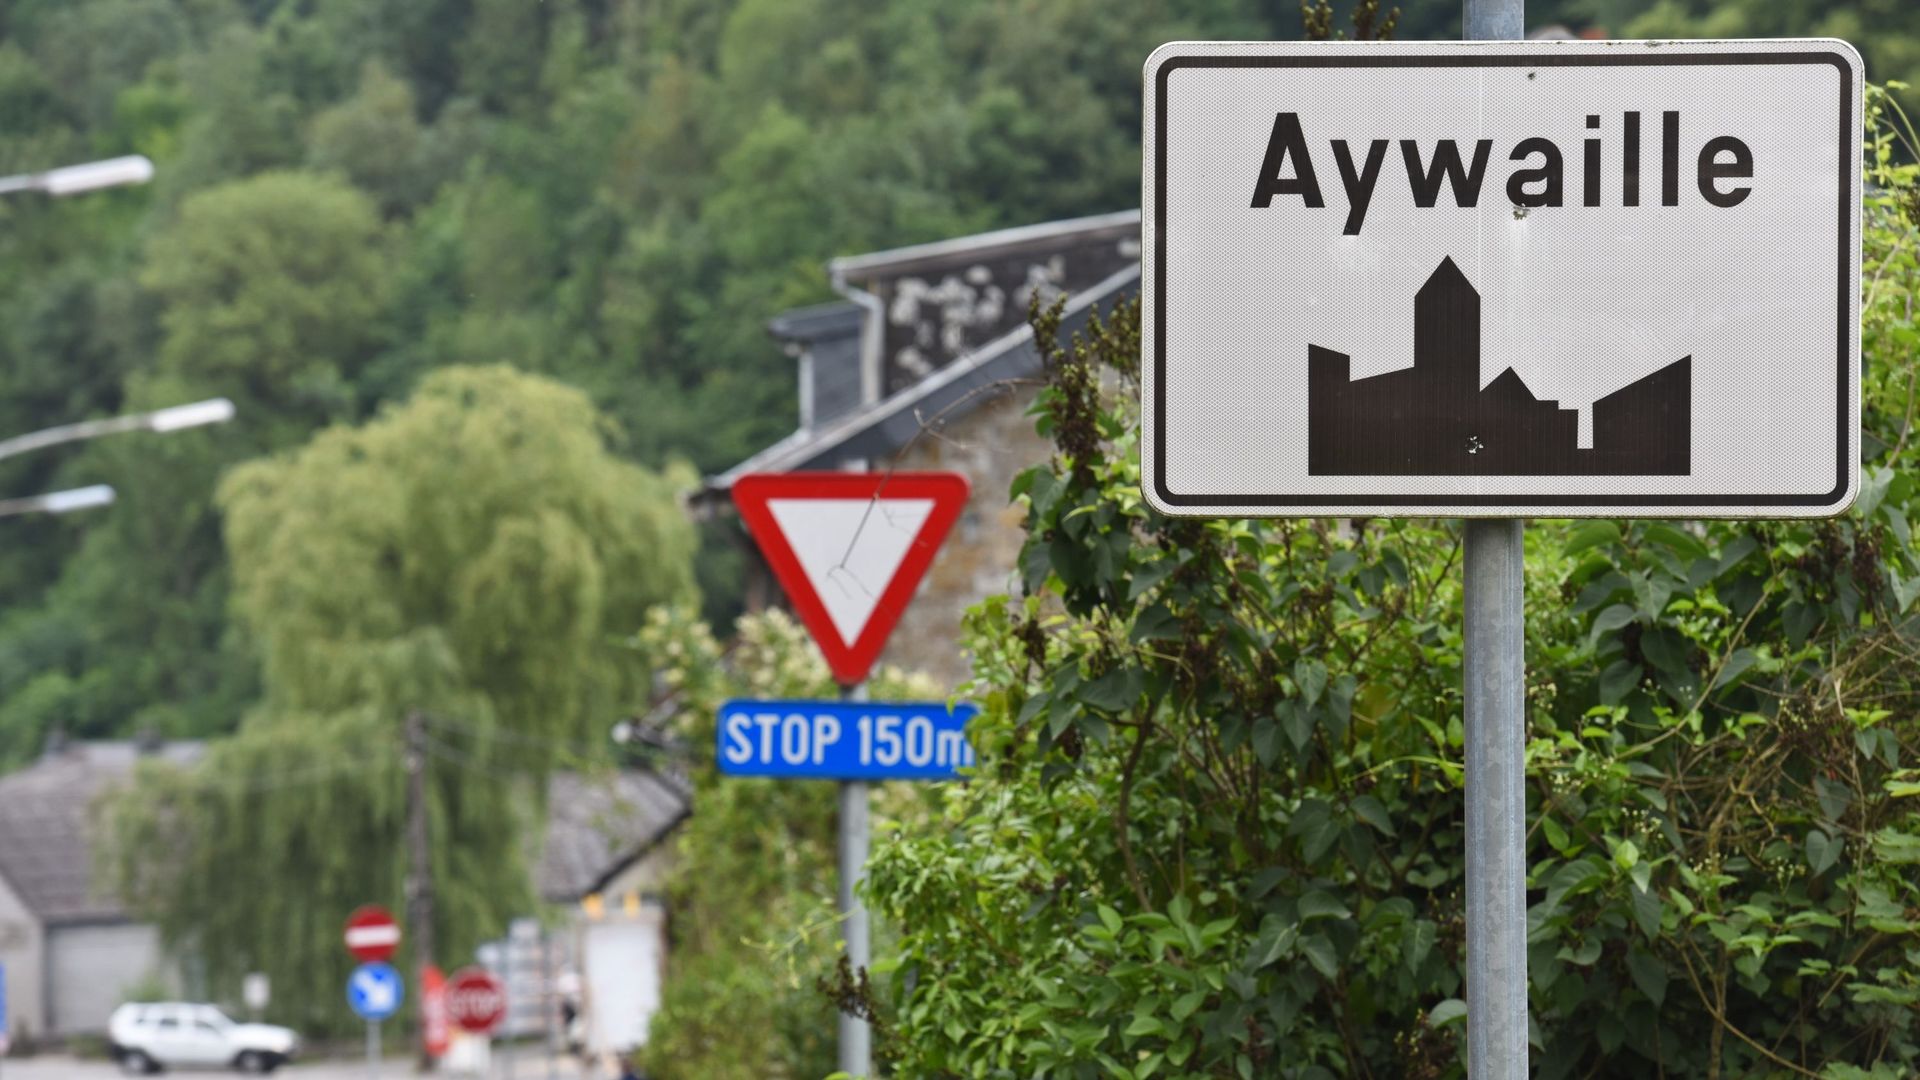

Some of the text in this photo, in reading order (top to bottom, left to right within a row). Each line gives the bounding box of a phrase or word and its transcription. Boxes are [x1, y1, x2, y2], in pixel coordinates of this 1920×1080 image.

[1250, 111, 1754, 235] Aywaille
[726, 713, 975, 767] STOP 150m
